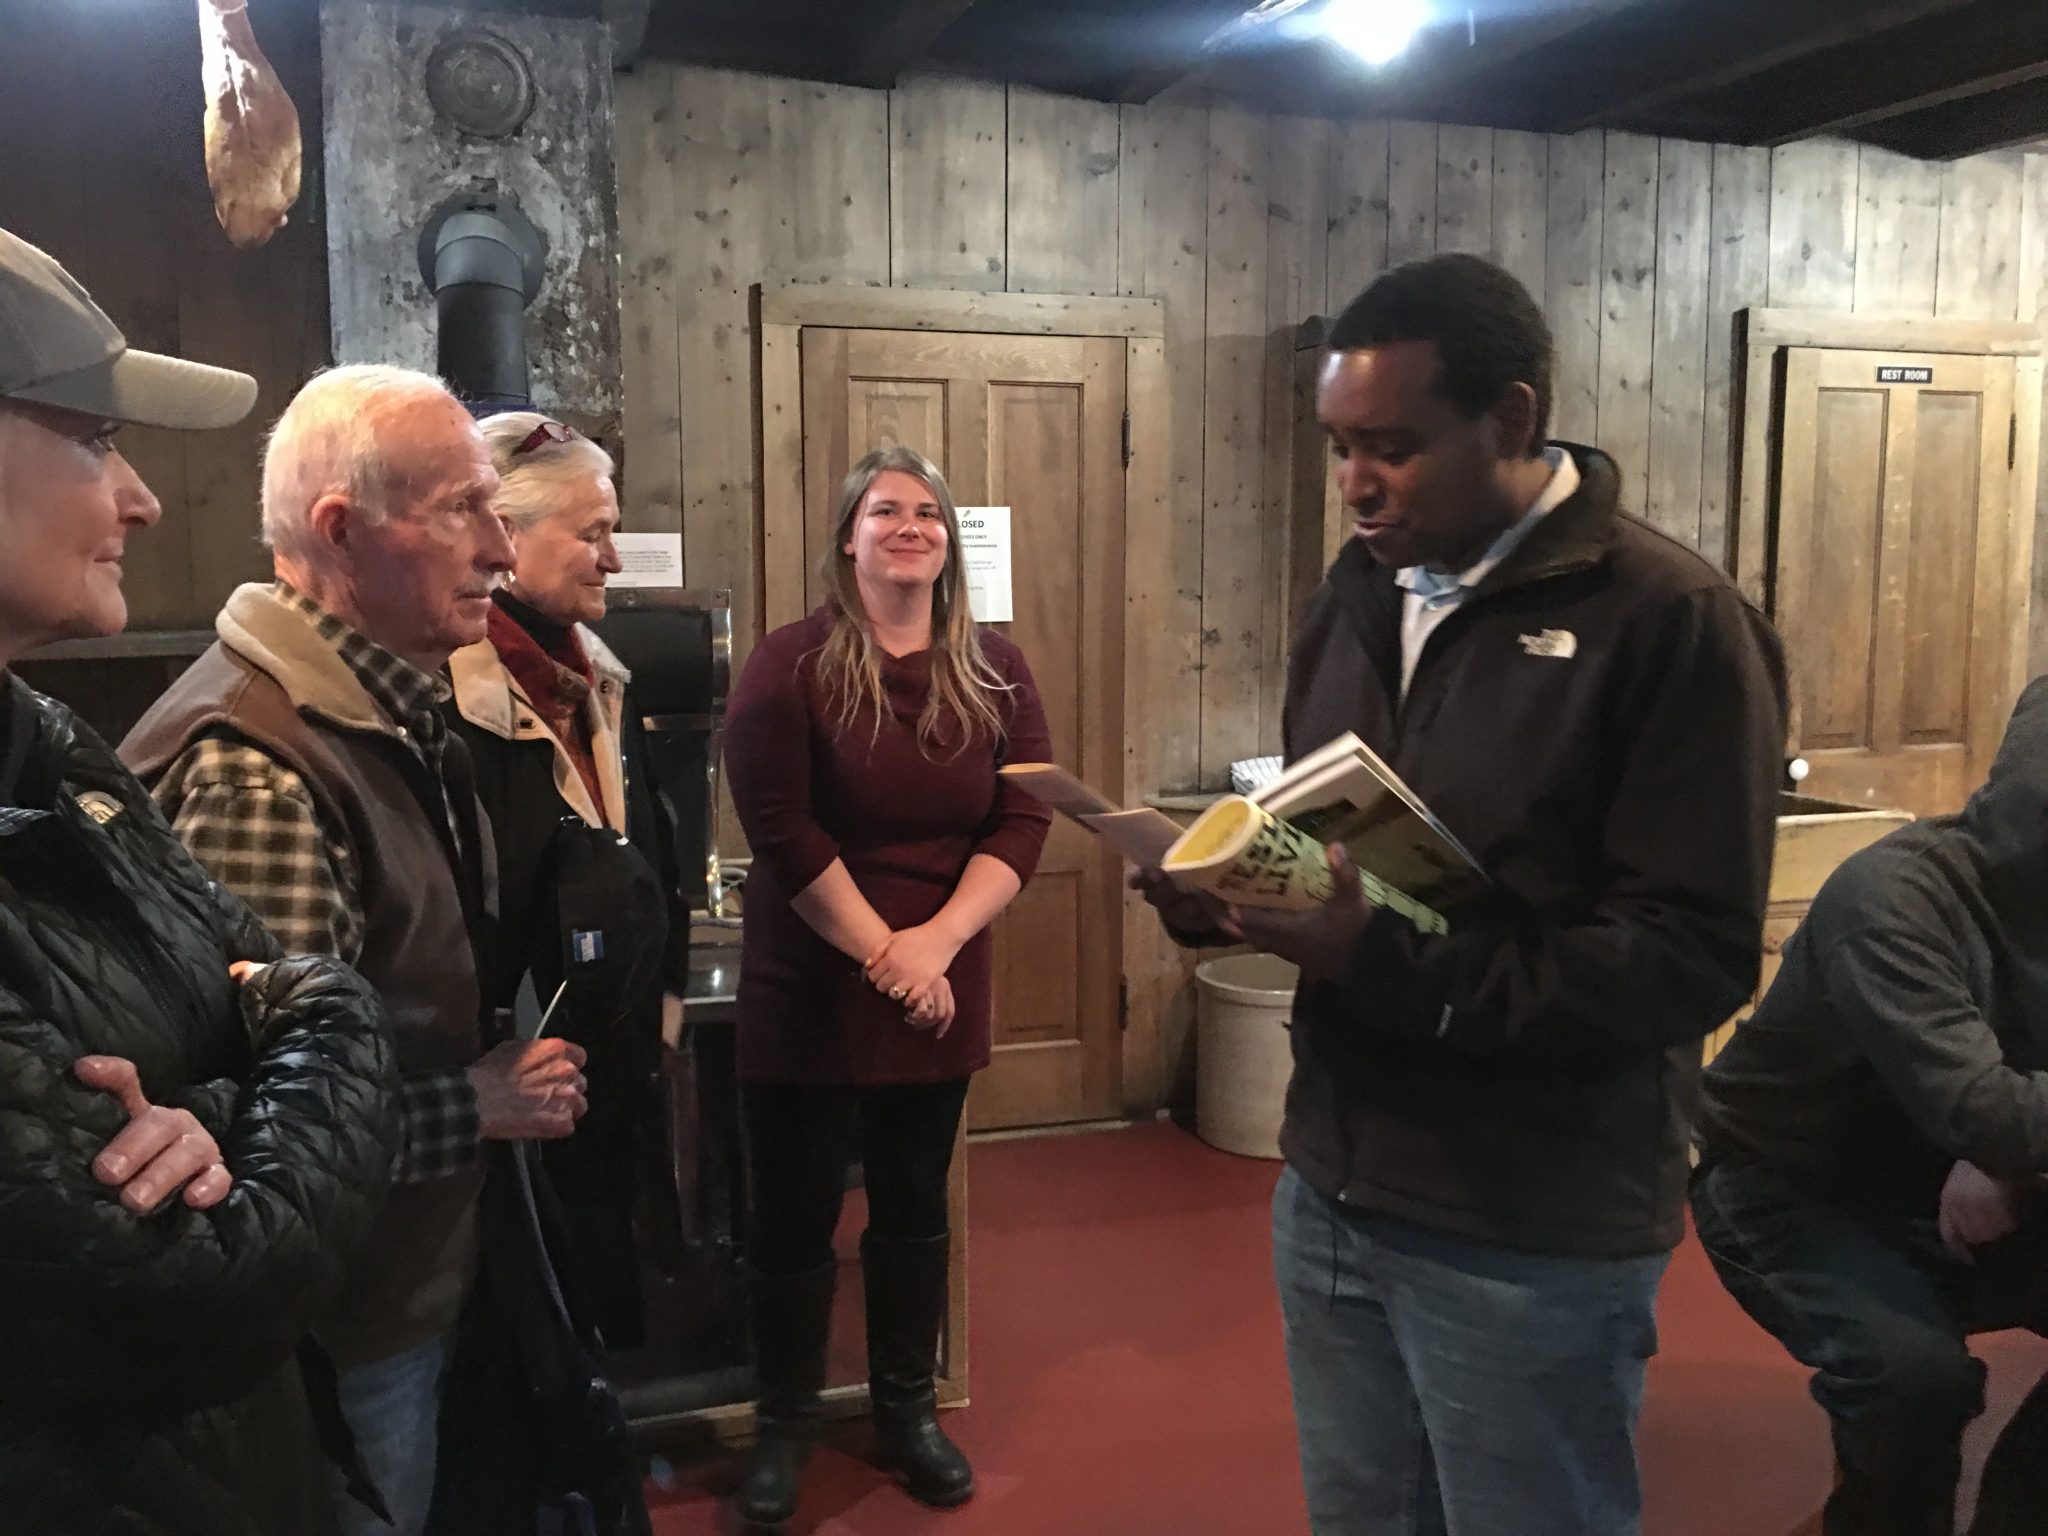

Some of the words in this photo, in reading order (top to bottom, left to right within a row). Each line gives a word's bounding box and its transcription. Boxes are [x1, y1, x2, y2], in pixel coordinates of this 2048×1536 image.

[1881, 369, 1902, 380] REST
[1904, 370, 1928, 381] ROOM
[958, 520, 985, 528] LOSED
